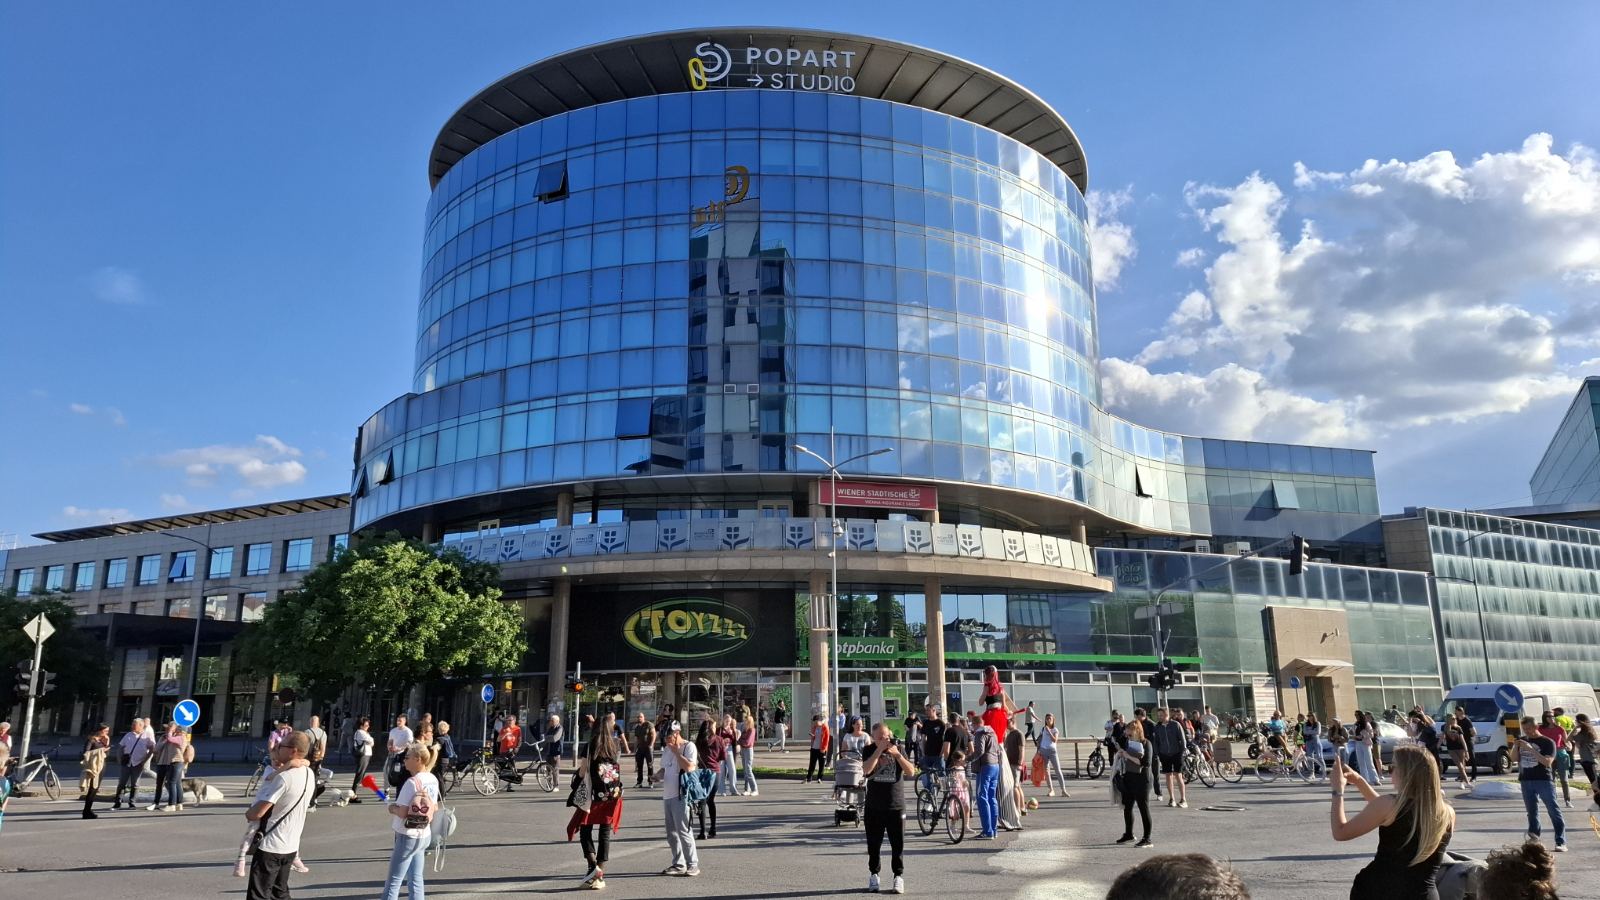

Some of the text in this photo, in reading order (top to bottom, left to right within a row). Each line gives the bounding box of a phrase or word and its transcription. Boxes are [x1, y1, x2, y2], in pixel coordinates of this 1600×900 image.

[746, 47, 856, 68] POPART
[770, 73, 855, 92] STUDIO
[837, 488, 866, 497] WIENER
